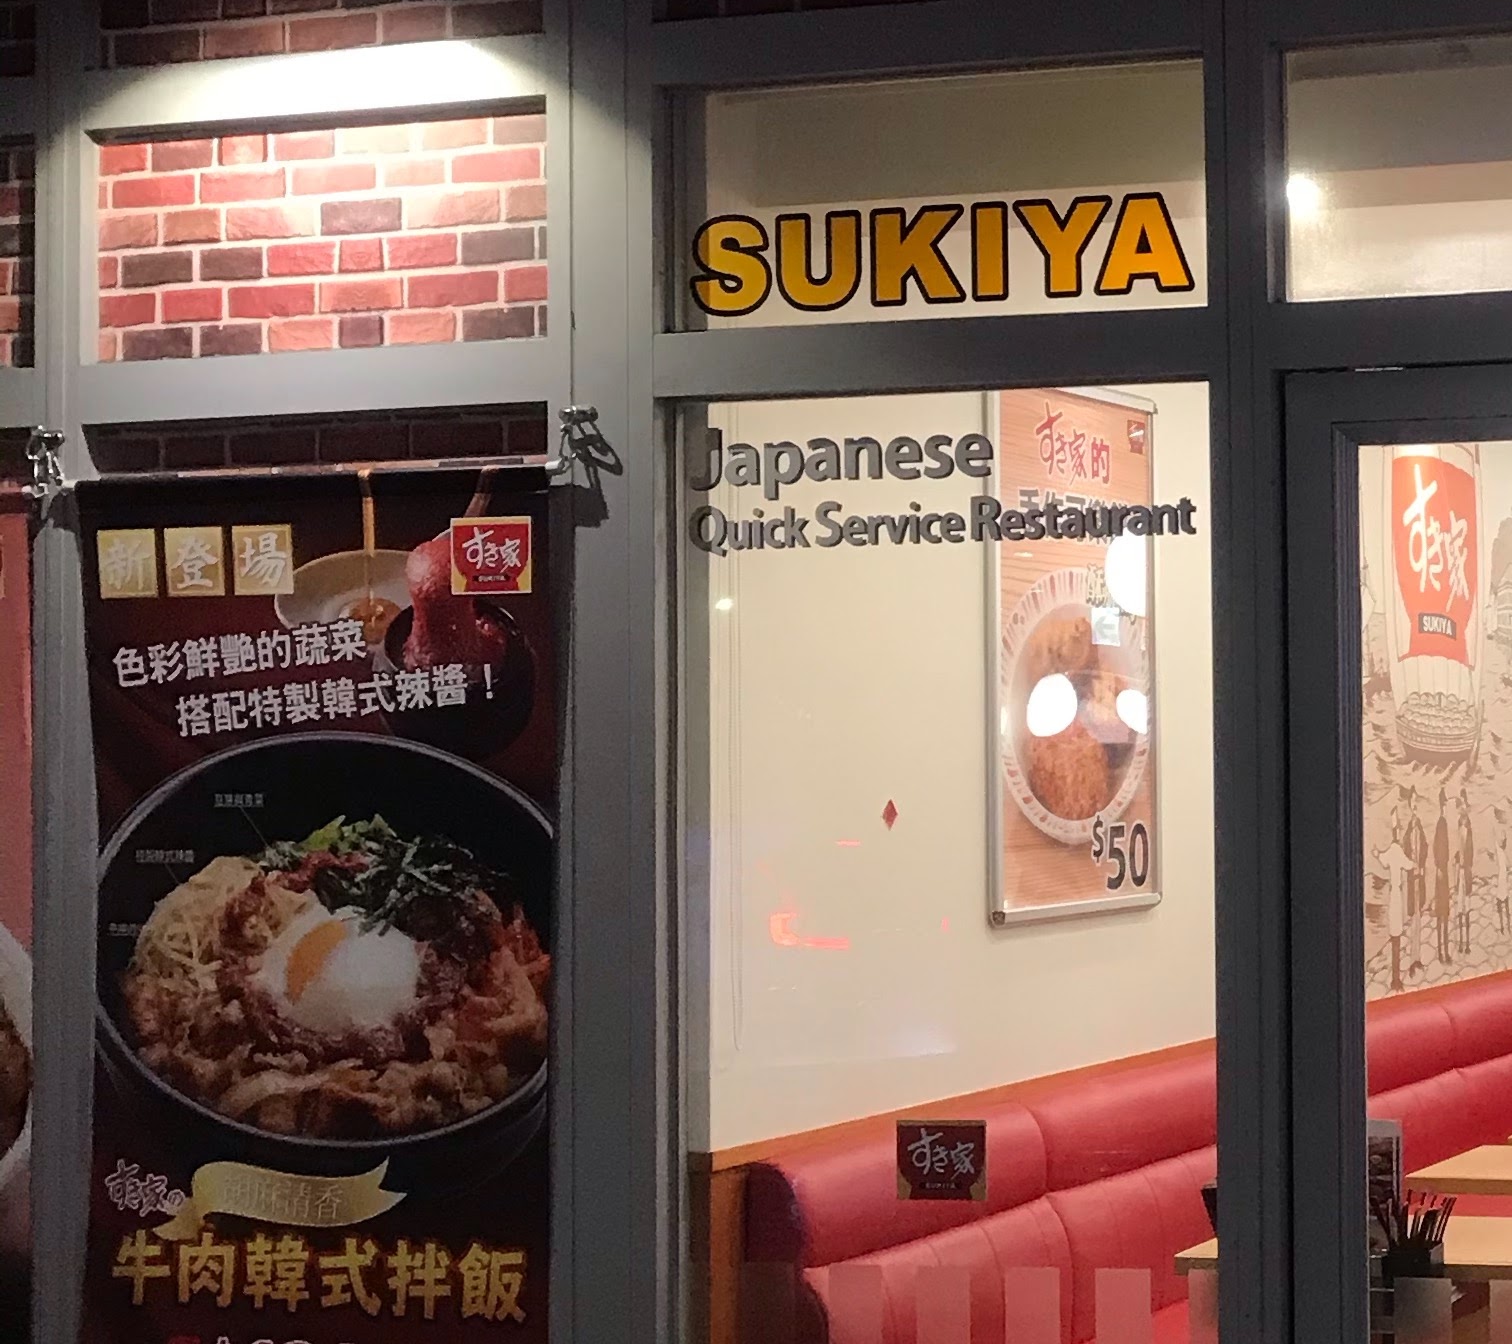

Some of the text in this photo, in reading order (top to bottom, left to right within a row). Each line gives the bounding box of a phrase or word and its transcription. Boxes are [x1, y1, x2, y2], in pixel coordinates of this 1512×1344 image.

[689, 192, 1195, 317] SUKIYA
[690, 428, 995, 500] Japanese
[462, 527, 521, 573] すき家
[690, 503, 812, 557] Quick
[814, 501, 966, 548] Service
[970, 495, 1197, 542] Restaurant
[1402, 464, 1469, 612] すき家
[104, 531, 288, 591] 新登場
[1423, 616, 1453, 637] SUKIYA
[1091, 813, 1149, 891] $50
[907, 1127, 975, 1180] すき家
[111, 1225, 528, 1324] 牛肉韓式拌飯
